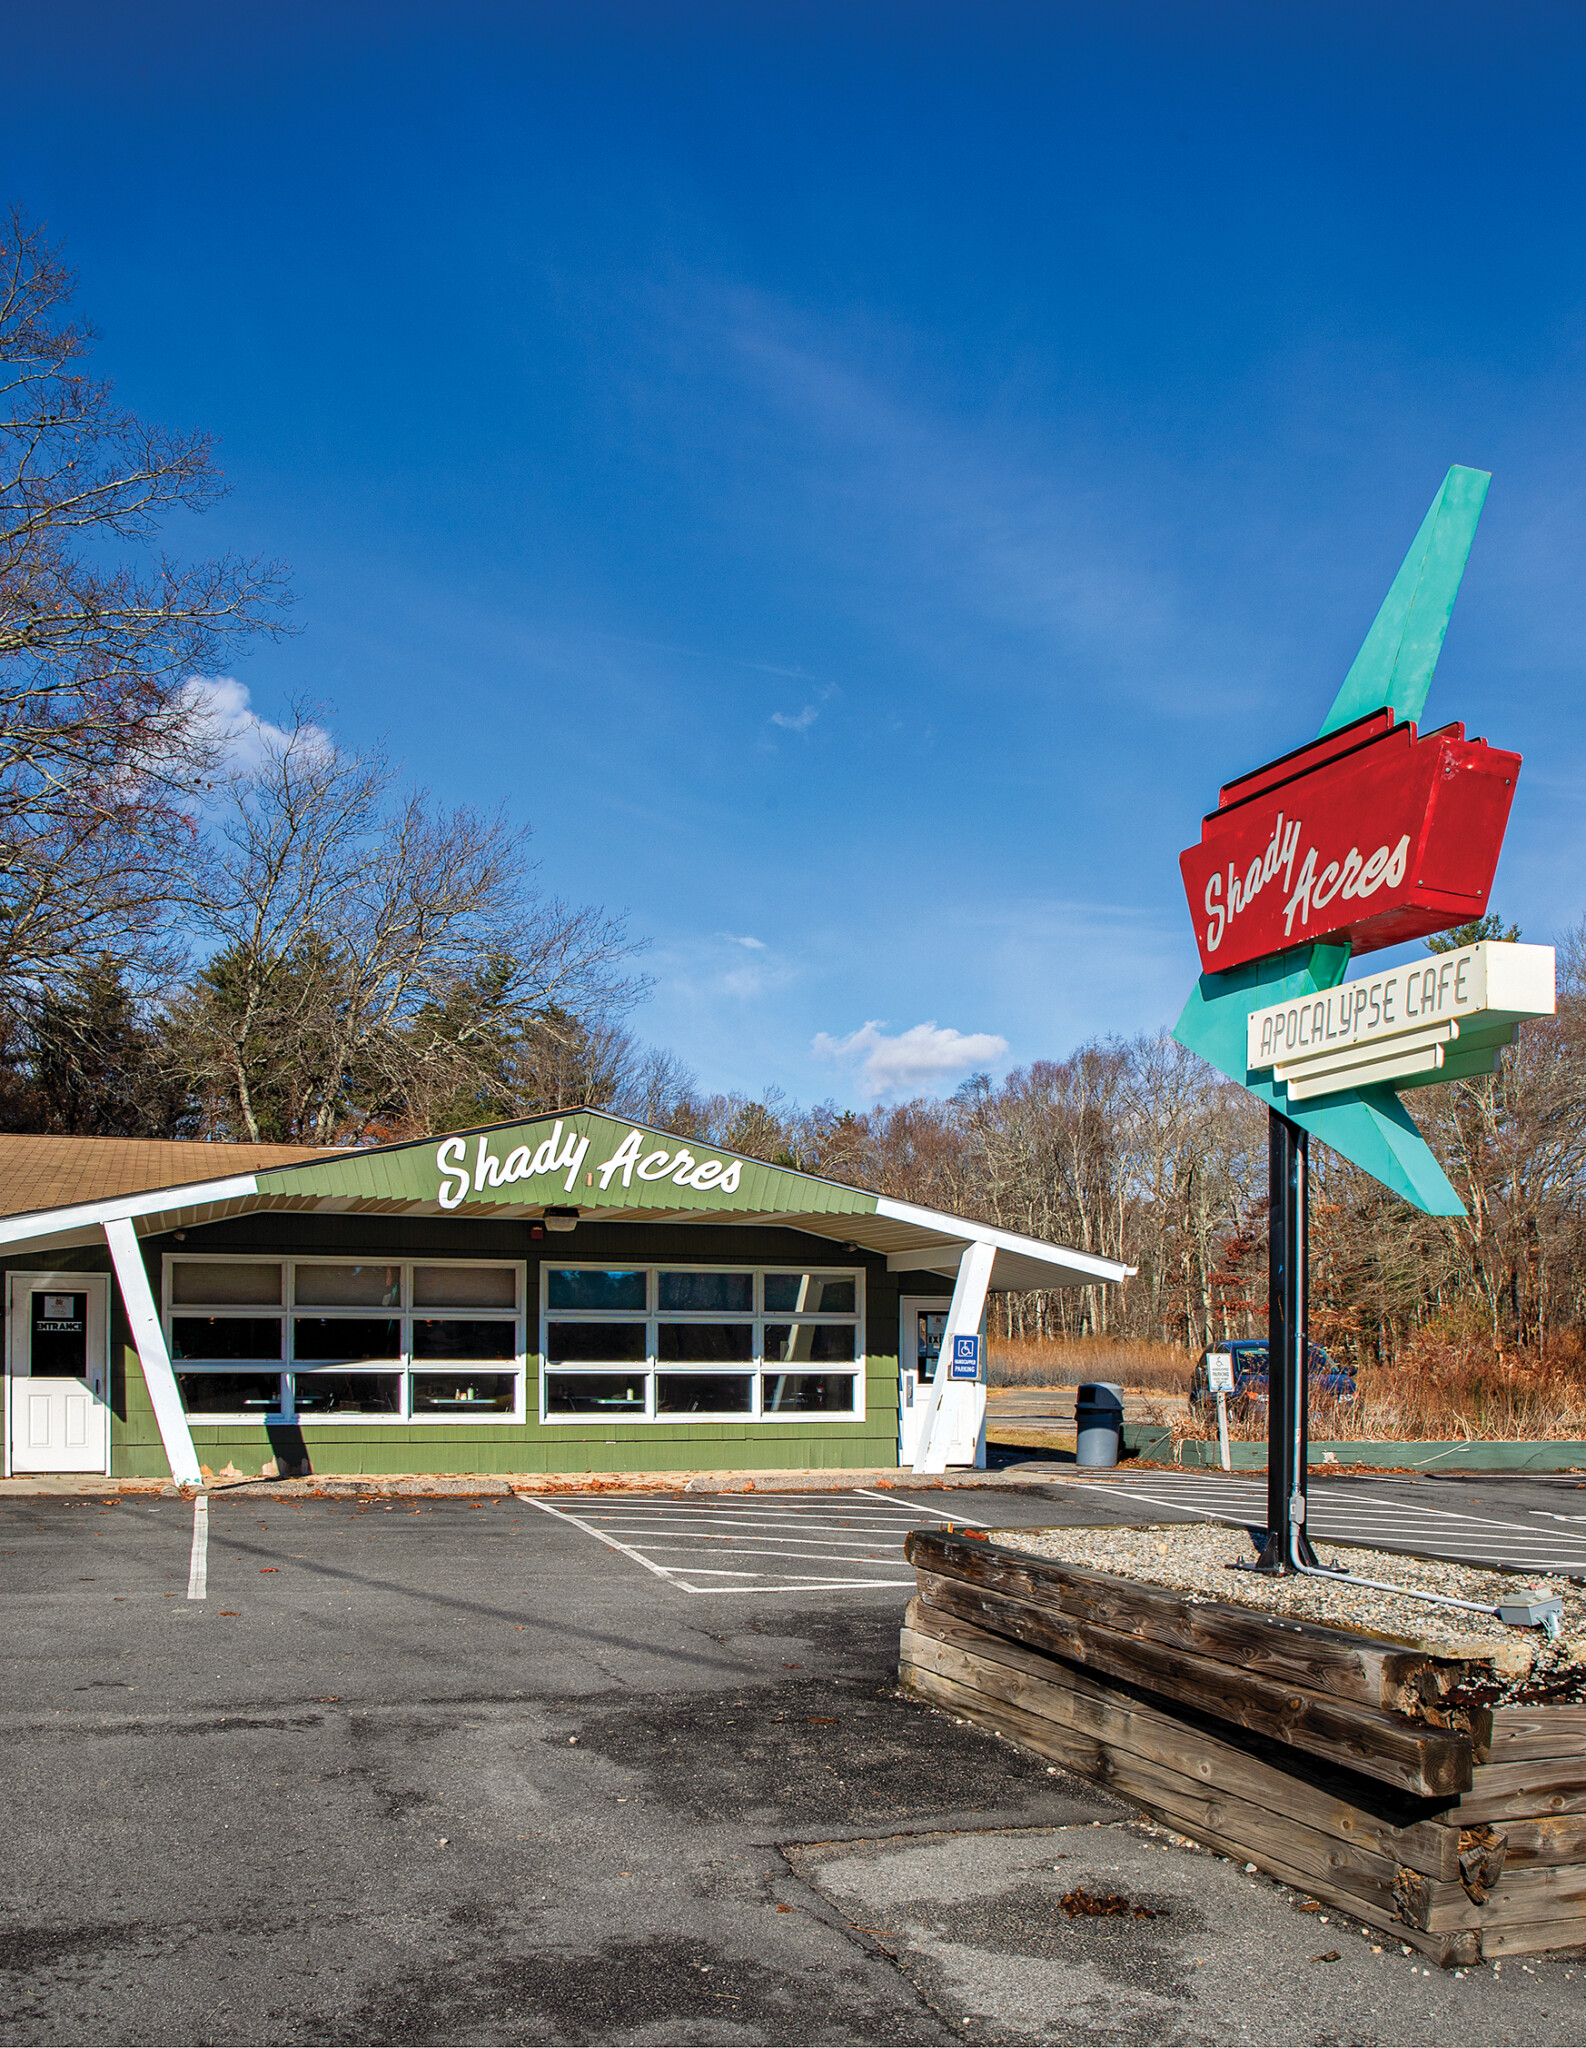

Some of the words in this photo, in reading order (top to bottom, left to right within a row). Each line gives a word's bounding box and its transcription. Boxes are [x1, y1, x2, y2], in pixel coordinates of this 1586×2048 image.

[1205, 811, 1302, 952] Shady
[1282, 834, 1411, 937] Acres
[1260, 978, 1397, 1058] APOCALYPSE
[1406, 956, 1471, 1018] CAFE
[436, 1119, 591, 1210] Shady
[596, 1128, 744, 1194] Acres
[37, 1322, 82, 1331] ENTRANCE
[928, 1336, 944, 1344] EXI
[954, 1365, 976, 1373] PARKING
